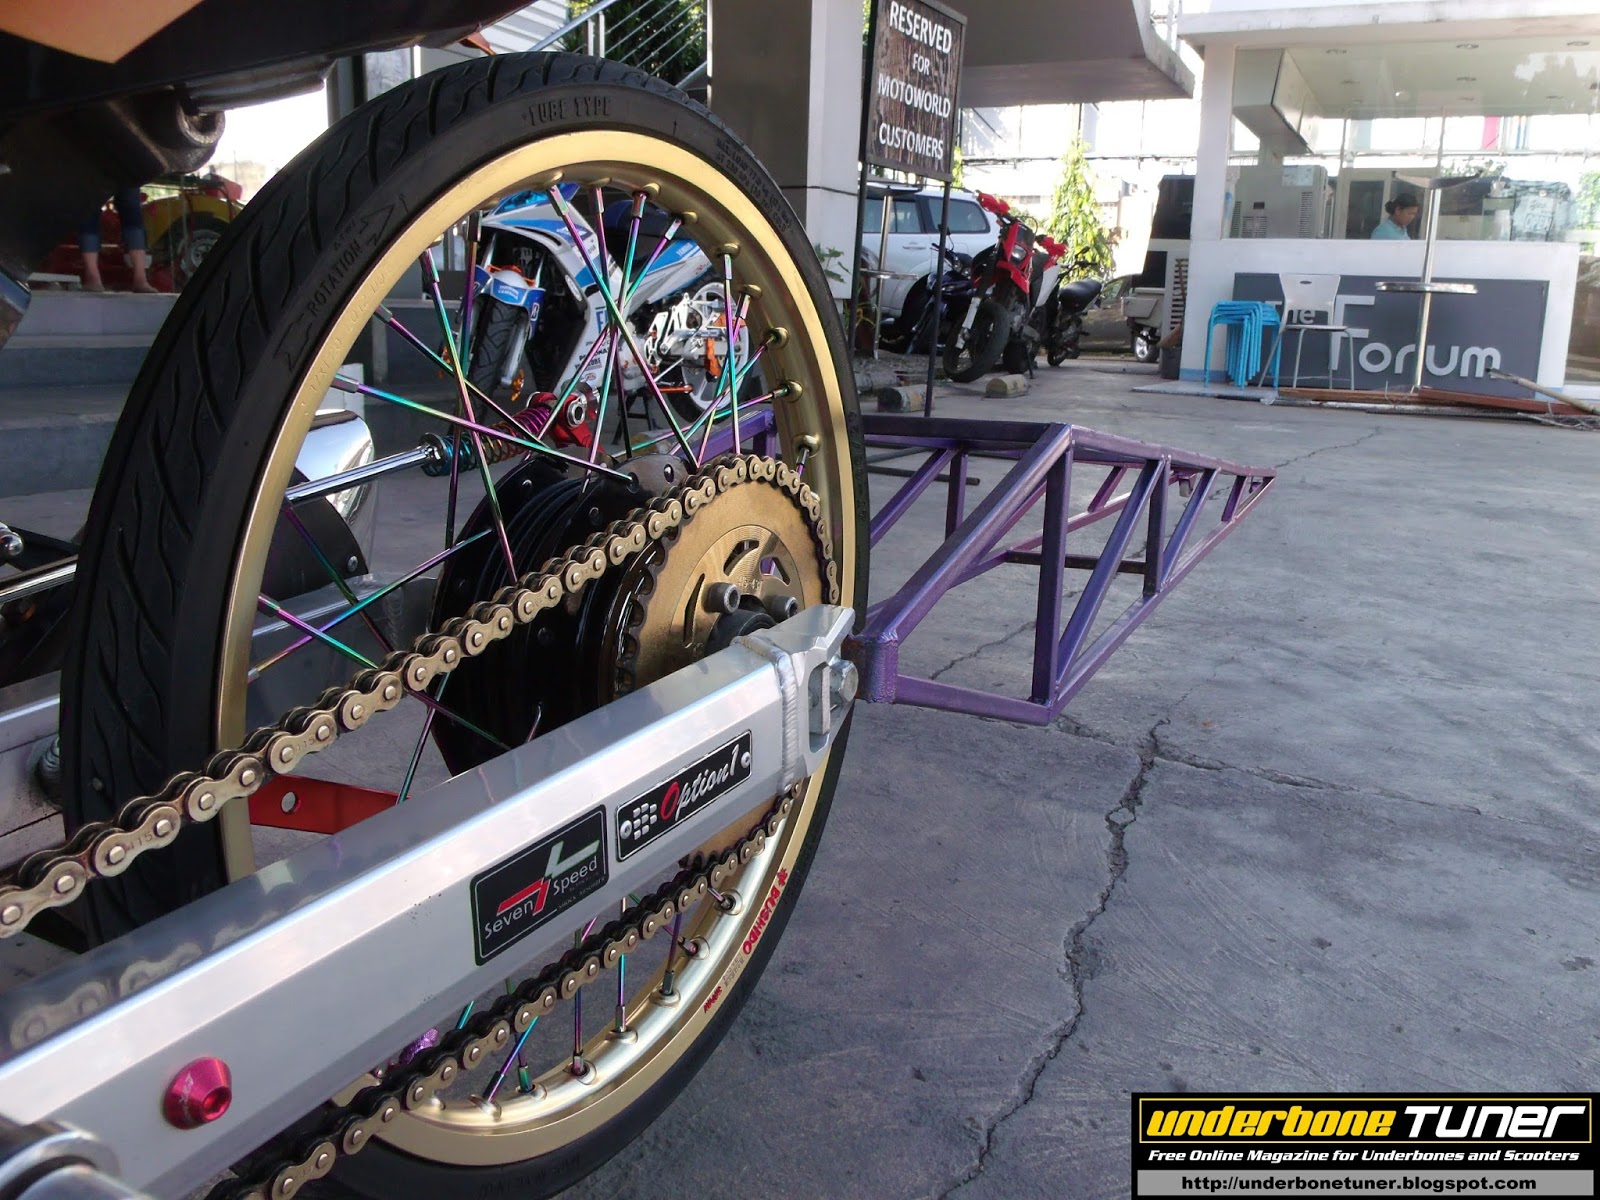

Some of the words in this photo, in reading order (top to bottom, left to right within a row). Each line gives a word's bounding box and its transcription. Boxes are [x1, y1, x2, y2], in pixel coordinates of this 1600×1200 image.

[889, 1, 952, 54] RESERVED
[912, 53, 930, 76] FOR
[878, 73, 951, 118] MOTOWORLD
[879, 122, 944, 160] CUSTOMERS
[307, 239, 362, 317] ROTATION
[1329, 294, 1501, 379] Forum
[743, 885, 780, 955] BUSHIDO
